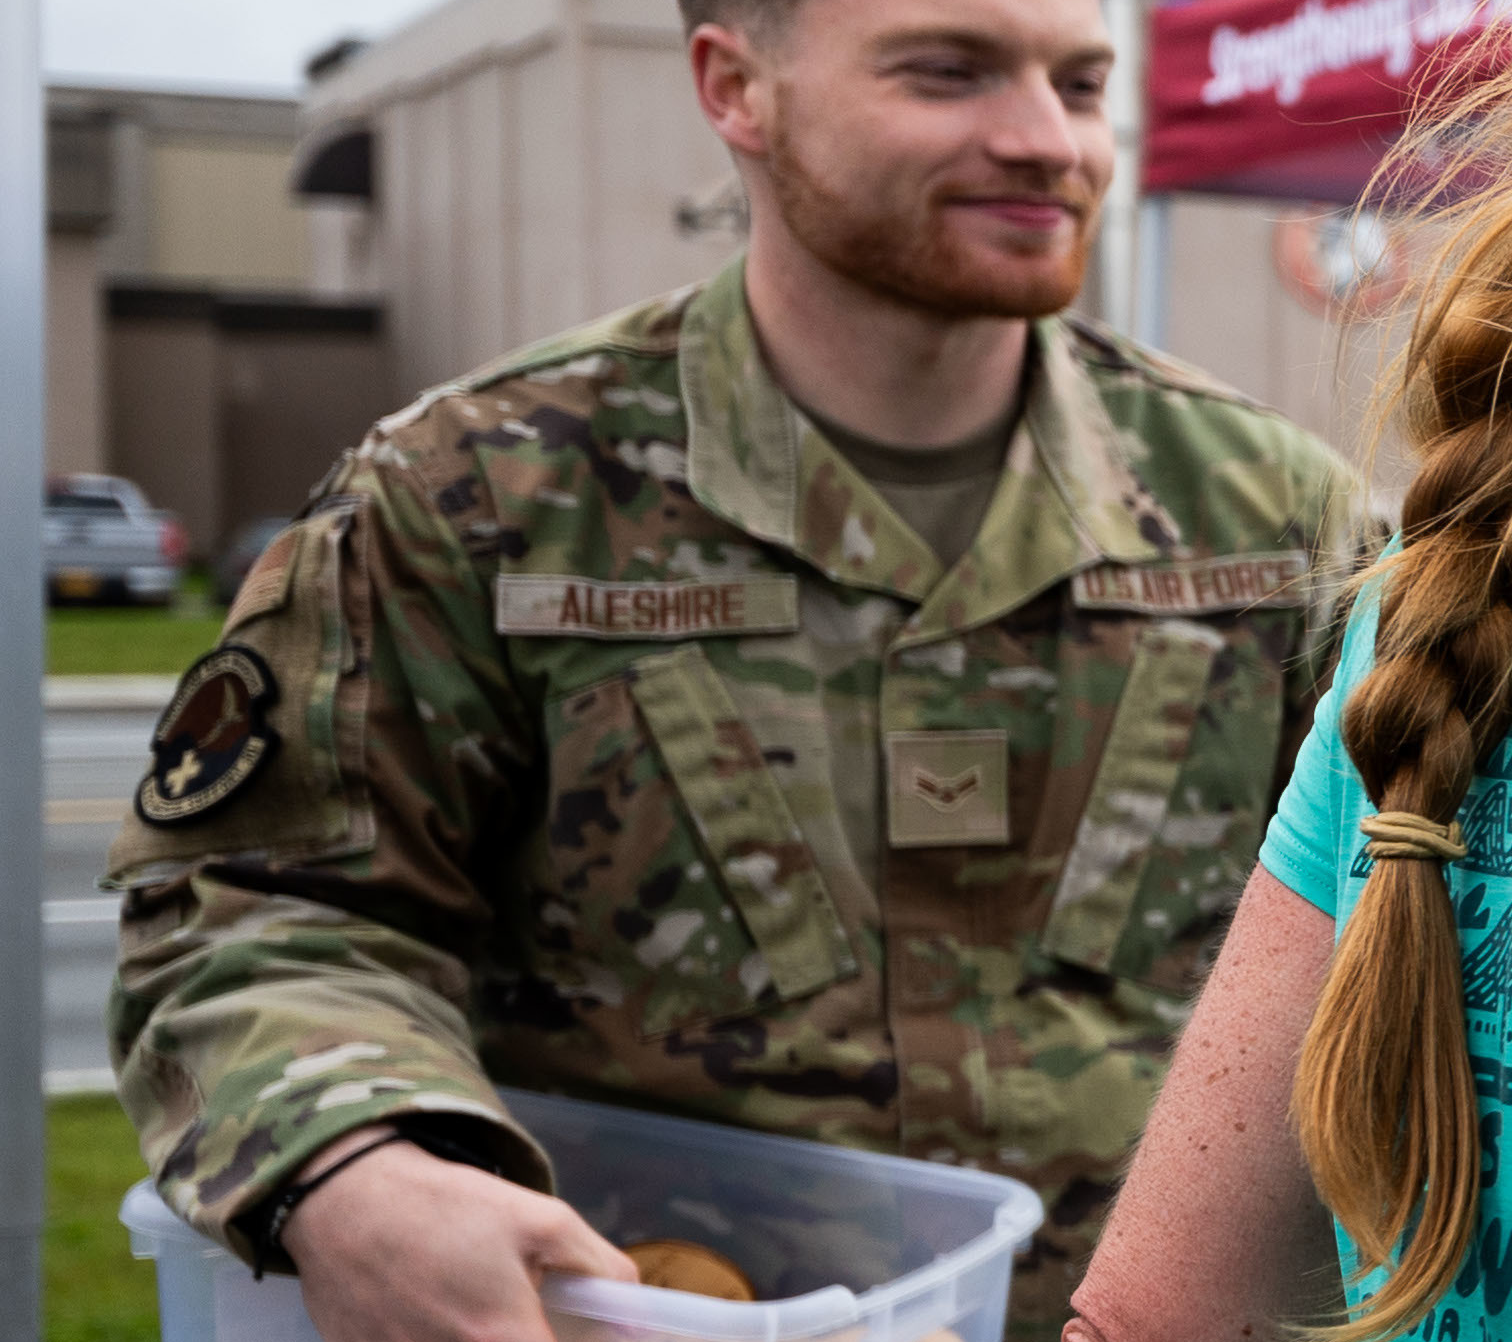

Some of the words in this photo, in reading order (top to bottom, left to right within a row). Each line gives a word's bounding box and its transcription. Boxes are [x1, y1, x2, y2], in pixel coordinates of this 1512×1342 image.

[560, 583, 745, 630] ALESHIRE
[1140, 568, 1187, 607] AIR
[1189, 560, 1304, 604] FORCE
